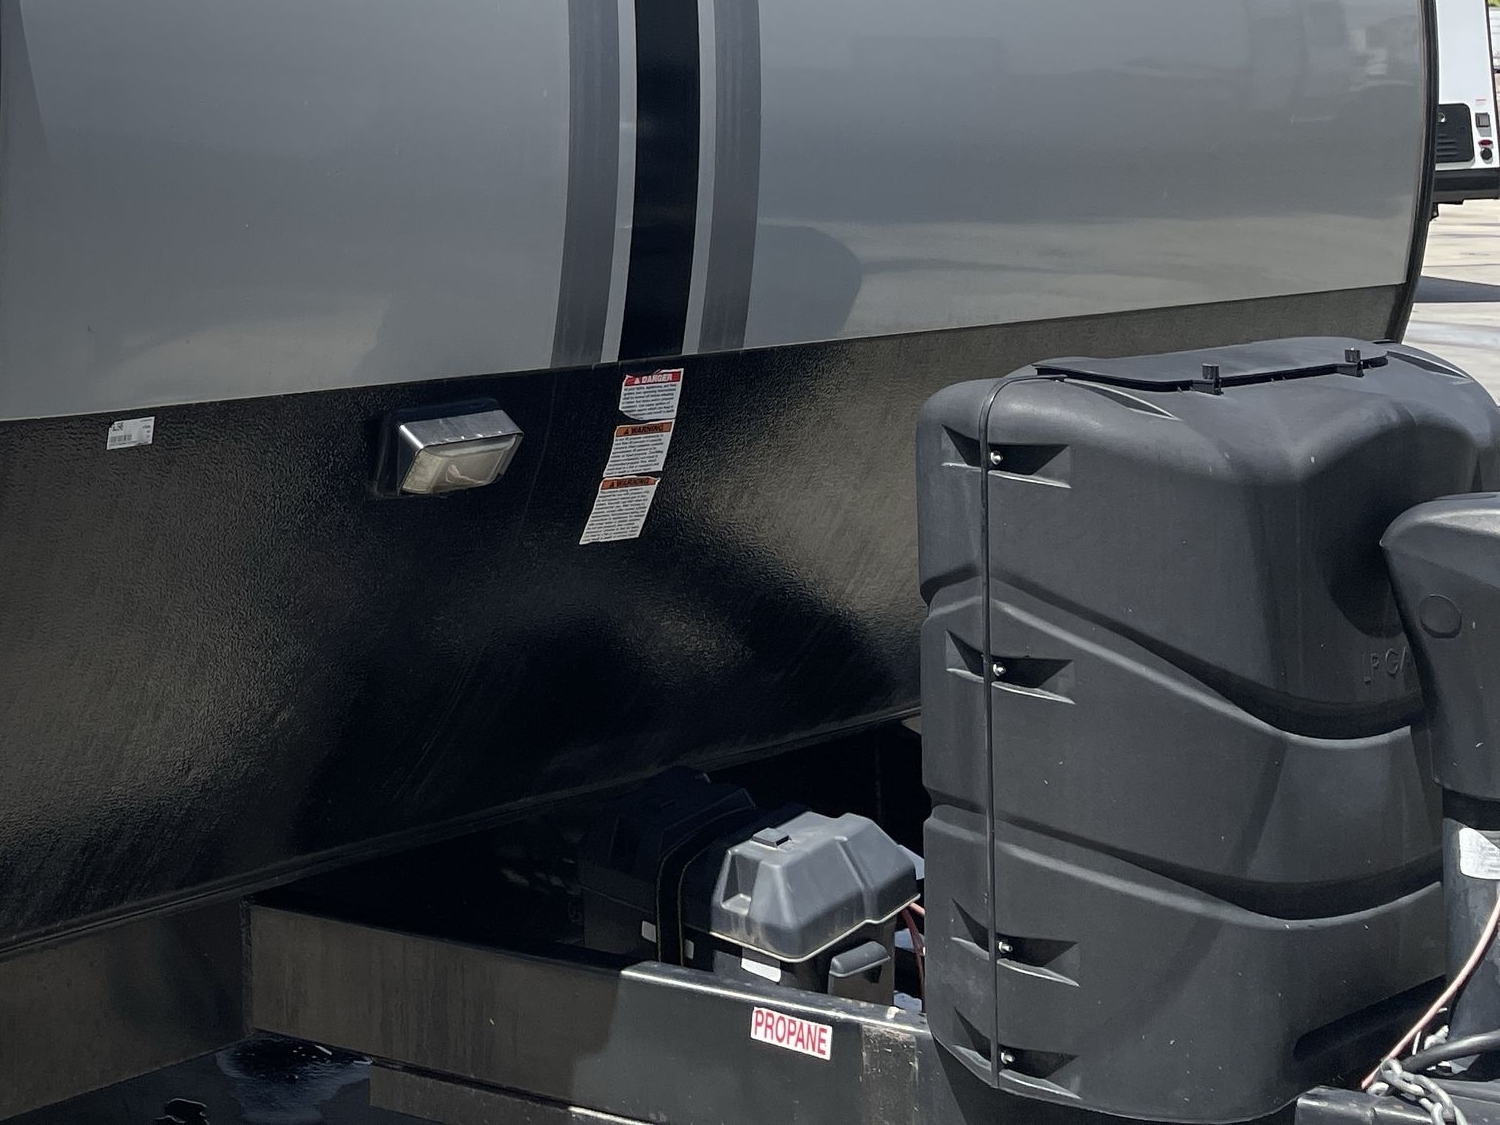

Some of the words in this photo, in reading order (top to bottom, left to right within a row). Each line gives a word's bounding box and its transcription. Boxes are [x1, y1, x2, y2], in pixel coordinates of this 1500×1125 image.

[641, 373, 673, 384] DANGER
[632, 423, 663, 435] WARNING
[754, 1009, 827, 1055] PROPANE
